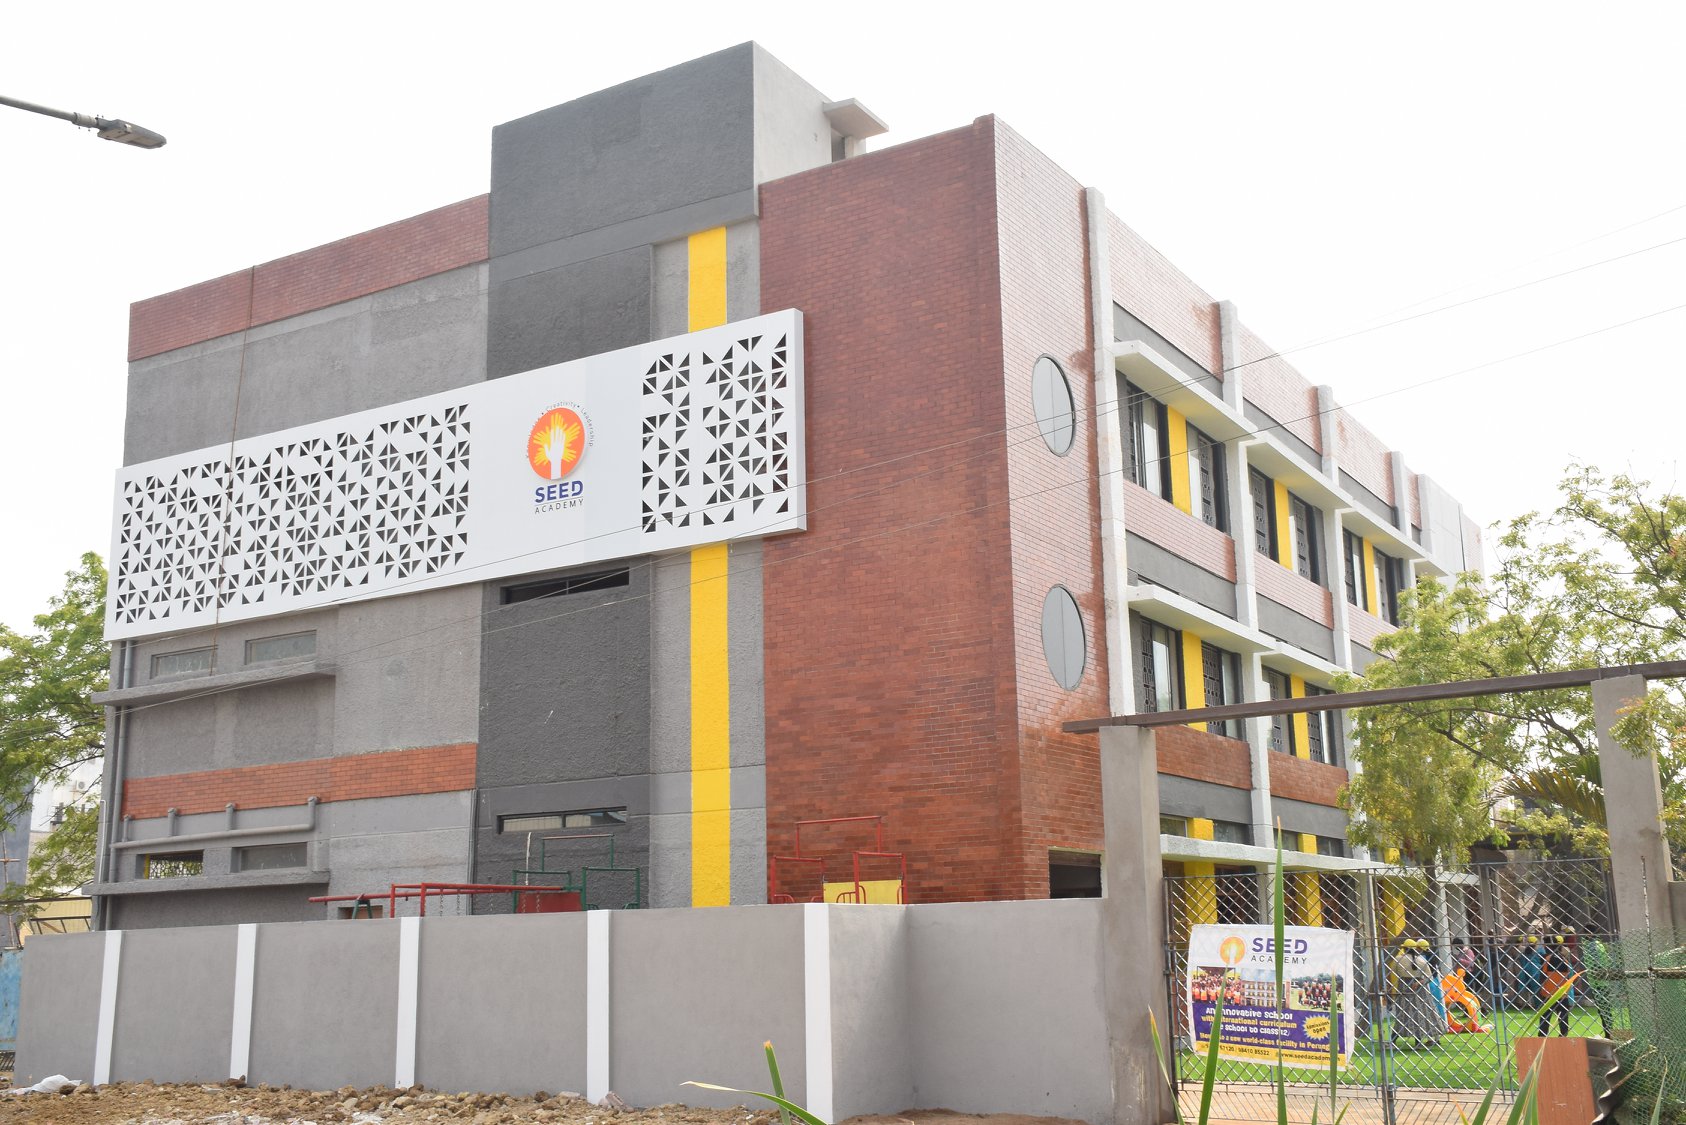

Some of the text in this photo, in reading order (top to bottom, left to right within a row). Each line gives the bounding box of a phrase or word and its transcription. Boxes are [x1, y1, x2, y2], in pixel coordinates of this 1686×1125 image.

[580, 407, 595, 447] Leadership
[535, 480, 584, 503] SEED
[534, 498, 584, 515] ACADEMY
[1252, 937, 1308, 955] SEED
[1250, 955, 1307, 965] ACAEMY
[1221, 1008, 1262, 1018] nnovative
